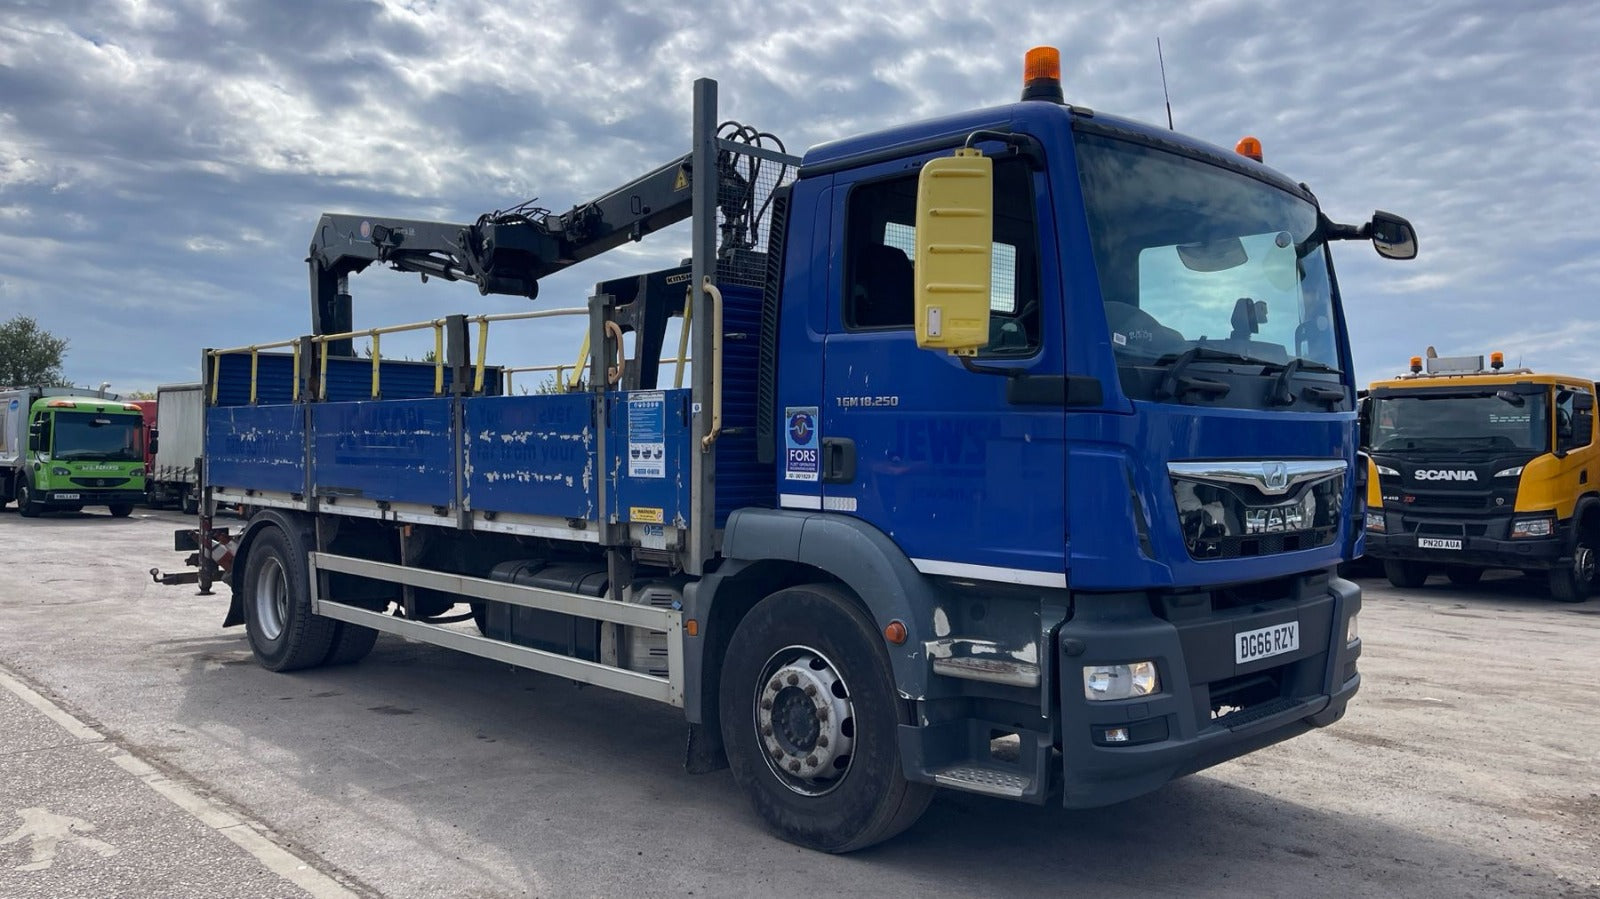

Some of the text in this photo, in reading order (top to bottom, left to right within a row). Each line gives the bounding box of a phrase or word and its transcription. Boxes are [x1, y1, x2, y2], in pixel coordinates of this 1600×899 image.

[859, 396, 899, 407] 18.250
[790, 450, 815, 461] FORS
[1414, 469, 1478, 481] SCANIA
[1245, 507, 1302, 534] MAN
[1423, 540, 1460, 549] PN20 AUA
[1241, 625, 1295, 659] DG66 RZY
